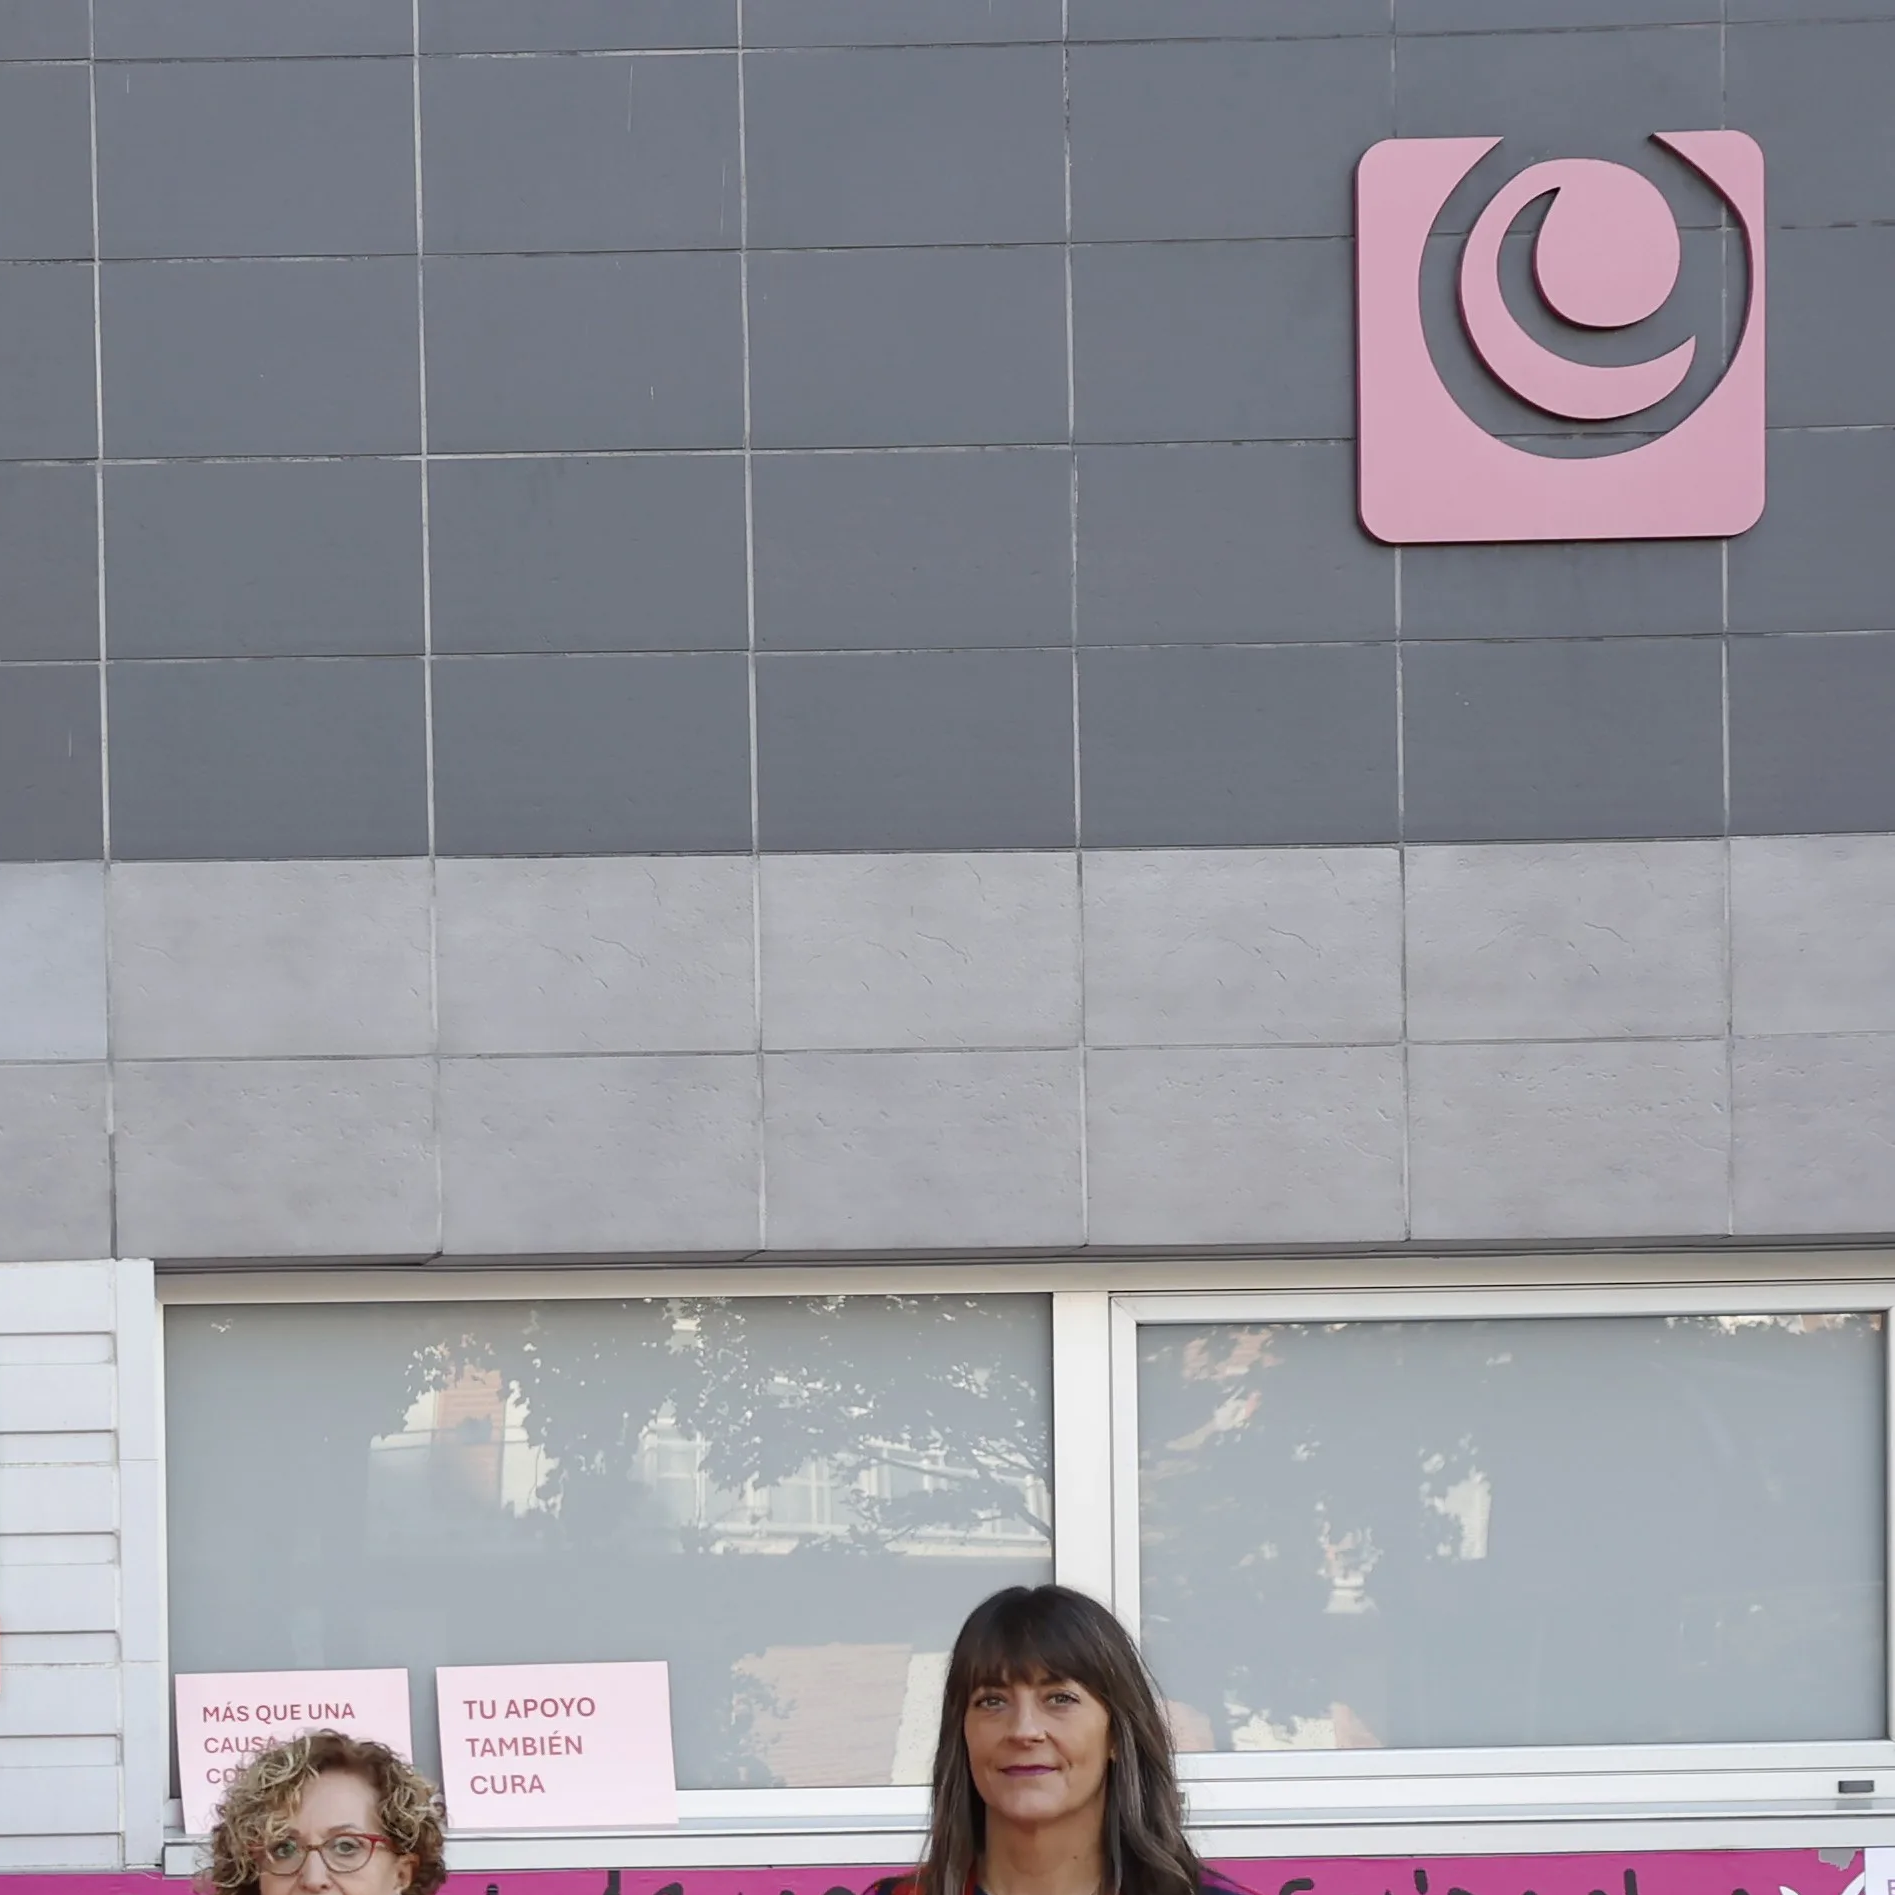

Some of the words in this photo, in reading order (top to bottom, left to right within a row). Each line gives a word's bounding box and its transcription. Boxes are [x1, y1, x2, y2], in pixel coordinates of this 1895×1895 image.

[203, 1702, 249, 1722] MÁS
[256, 1704, 301, 1724] QUE
[308, 1703, 355, 1720] UNA
[463, 1700, 496, 1719] TU
[505, 1697, 595, 1718] APOYO
[466, 1731, 582, 1757] TAMBIÉN
[470, 1774, 545, 1794] CURA
